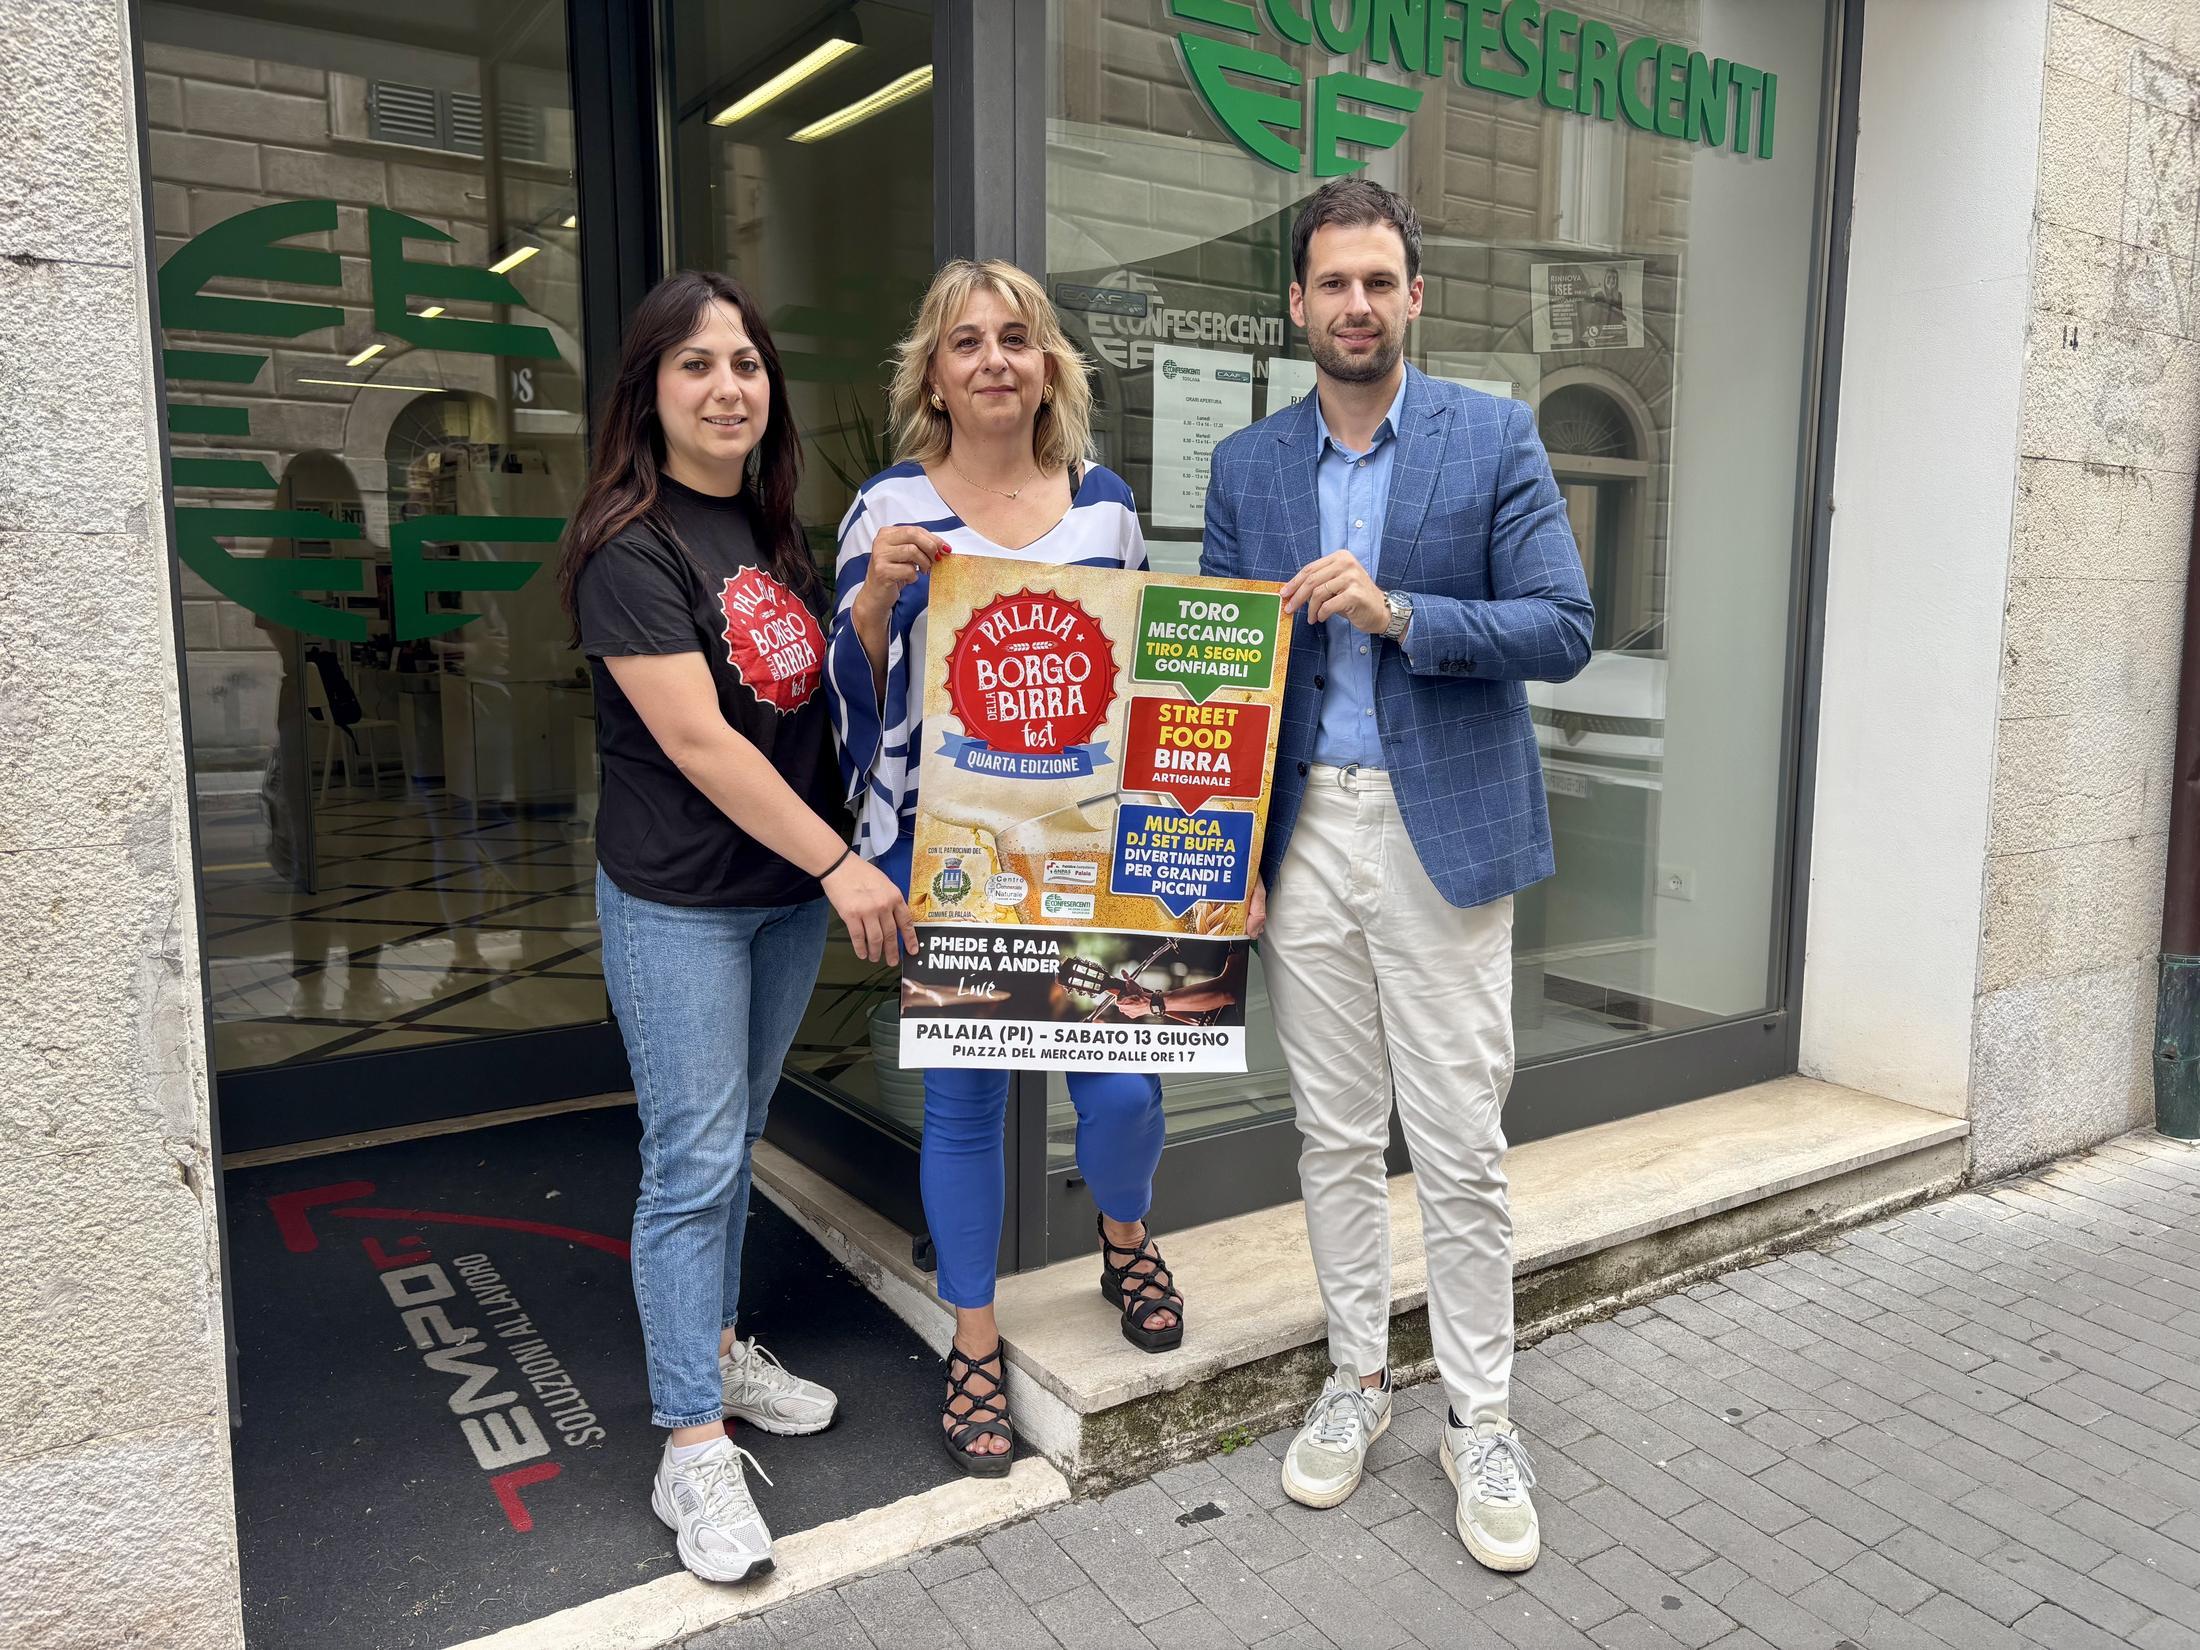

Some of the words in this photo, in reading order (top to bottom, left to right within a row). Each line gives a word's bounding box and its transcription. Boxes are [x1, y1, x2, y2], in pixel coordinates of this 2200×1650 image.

[1179, 601, 1239, 622] TORO
[749, 612, 806, 657] BORGO
[978, 604, 1078, 646] PALAIA
[1148, 621, 1264, 645] MECCANICO
[773, 638, 817, 680] BIRRA
[1146, 642, 1183, 657] TIRO
[1187, 645, 1198, 658] A
[1203, 646, 1262, 663] SEGNO
[976, 651, 1091, 690] BORGO
[1155, 658, 1248, 678] GONFIABILI
[986, 692, 998, 720] DELLA
[997, 684, 1087, 722] BIRRA
[1158, 704, 1238, 726] STREET
[1021, 720, 1056, 747] fest
[1159, 725, 1232, 749] FOOD
[967, 751, 1016, 772] QUARTA
[1020, 758, 1080, 774] EDIZIONE
[1154, 748, 1231, 773] BIRRA
[1152, 773, 1231, 787] ARTIGIANALE
[1144, 815, 1221, 836] MUSICA
[1126, 832, 1147, 846] DJ
[1151, 834, 1180, 848] SET
[1184, 836, 1236, 852] BUFFA
[1125, 848, 1235, 868] DIVERTIMENTO
[1125, 863, 1152, 877] PER
[1157, 866, 1219, 882] GRANDI
[1223, 871, 1231, 882] E
[1152, 880, 1207, 896] PICCINI
[930, 936, 988, 952] PHEDE
[992, 938, 1007, 954] &
[1013, 939, 1060, 955] PAJA
[928, 954, 992, 971] NINNA
[998, 956, 1060, 973] ANDER
[958, 974, 996, 1000] Live
[916, 1024, 993, 1040] PALAIA
[1000, 1026, 1033, 1045] (PI)
[1054, 1028, 1128, 1045] SABATO
[1134, 1030, 1151, 1045] 13
[1157, 1032, 1229, 1046] GIUGNO
[952, 1045, 1007, 1058] PIAZZA
[1012, 1048, 1036, 1058] DEL
[1041, 1049, 1103, 1060] MERCATO
[1108, 1051, 1147, 1061] DALLE
[1151, 1052, 1174, 1062] ORE
[452, 1253, 521, 1316] LAVORO
[493, 1314, 537, 1338] AL
[507, 1339, 606, 1447] SOLUZIONI
